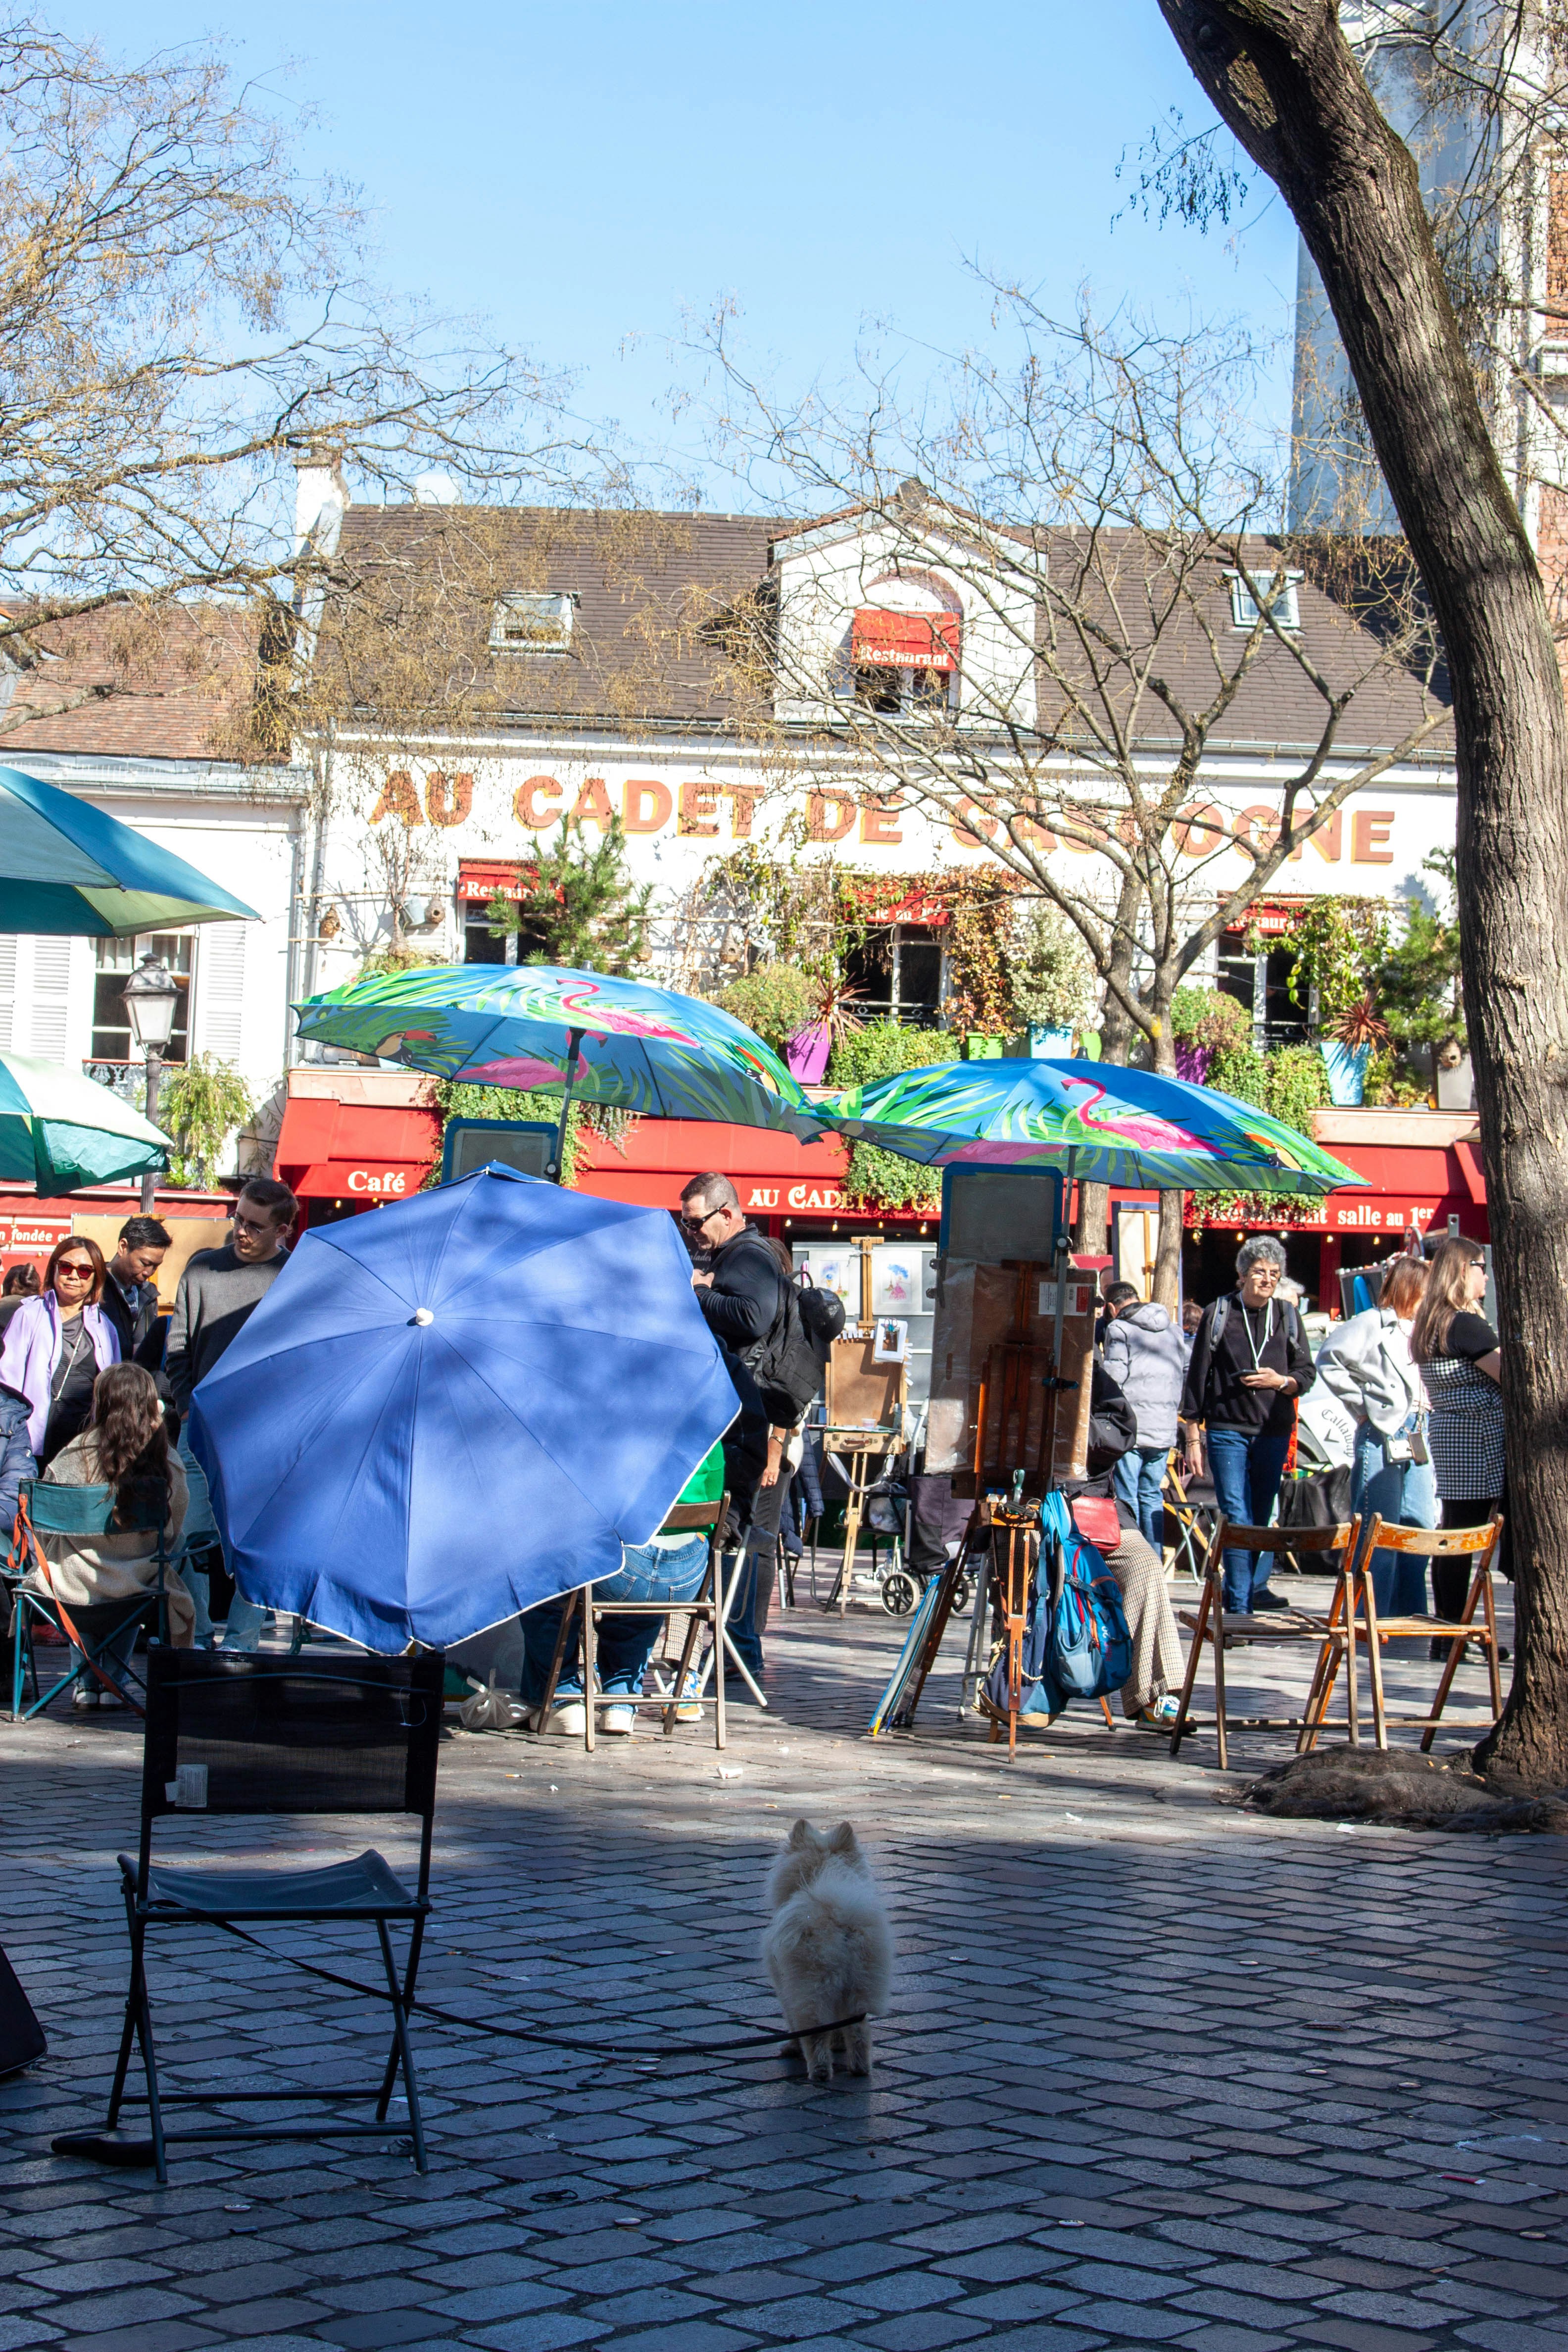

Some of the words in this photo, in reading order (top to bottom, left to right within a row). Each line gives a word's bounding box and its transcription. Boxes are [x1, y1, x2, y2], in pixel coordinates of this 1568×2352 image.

[861, 645, 948, 666] Restaurant
[369, 770, 473, 827] AU
[513, 775, 764, 838] CADET
[806, 787, 904, 845] DE
[348, 1171, 405, 1192] Café
[748, 1188, 780, 1207] AU
[1338, 1205, 1381, 1225] salle
[1386, 1212, 1404, 1226] au
[1410, 1207, 1434, 1226] 1er
[11, 1228, 53, 1242] fondée
